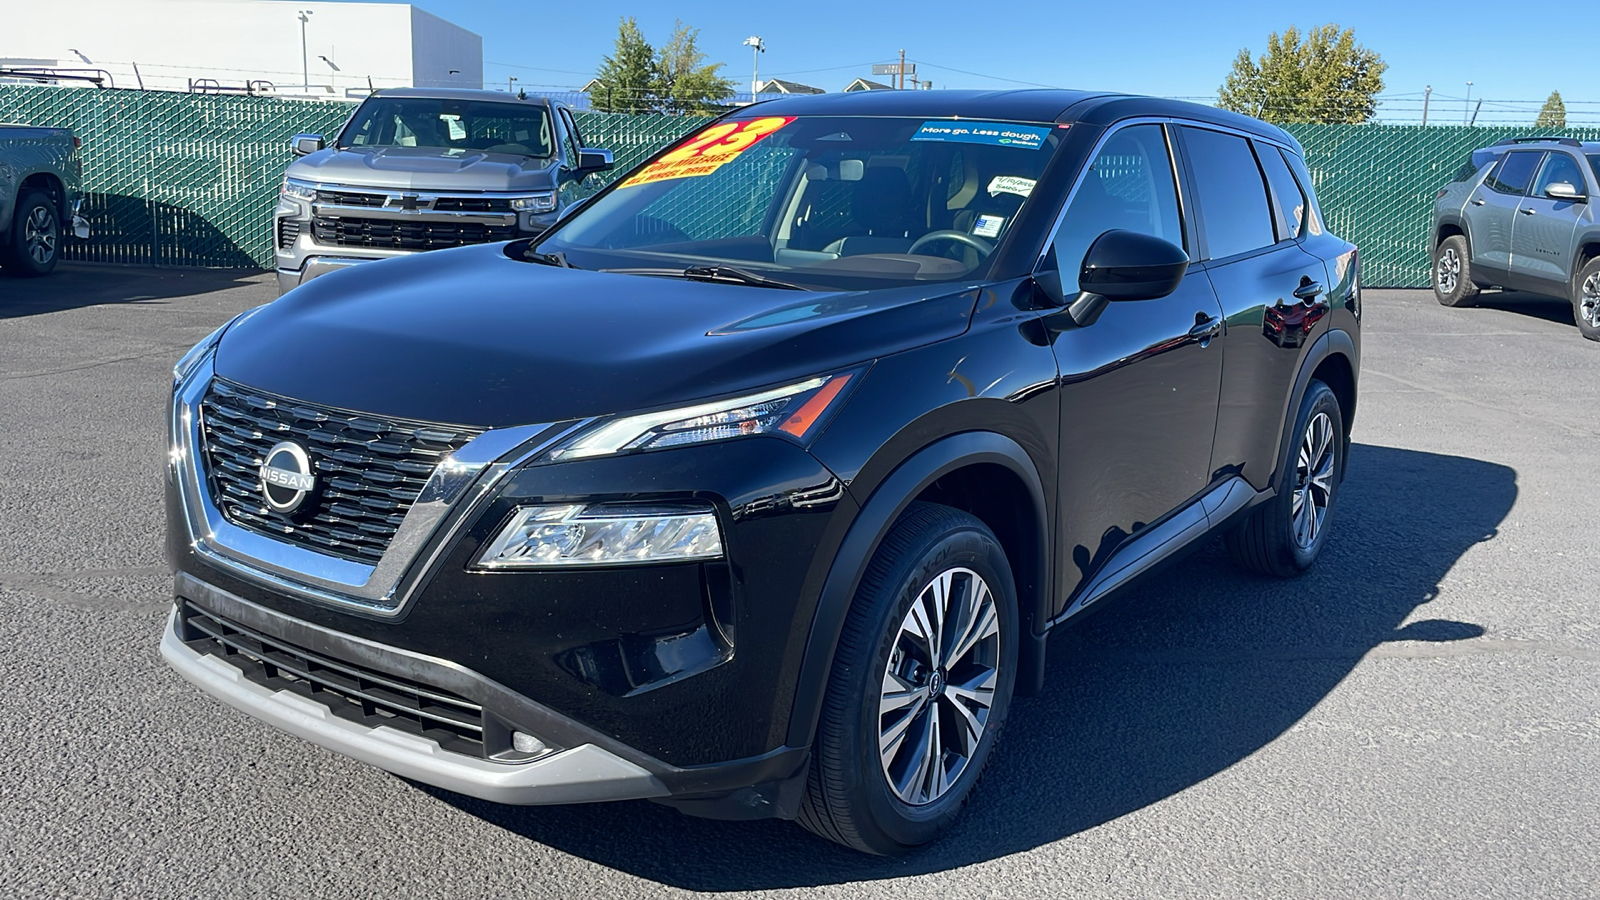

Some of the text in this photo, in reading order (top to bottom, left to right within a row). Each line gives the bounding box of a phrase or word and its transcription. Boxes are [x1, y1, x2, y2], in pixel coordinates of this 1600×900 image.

[658, 117, 786, 162] 23
[972, 128, 999, 136] Less
[1001, 131, 1041, 141] dough.
[259, 466, 312, 489] NISSAN
